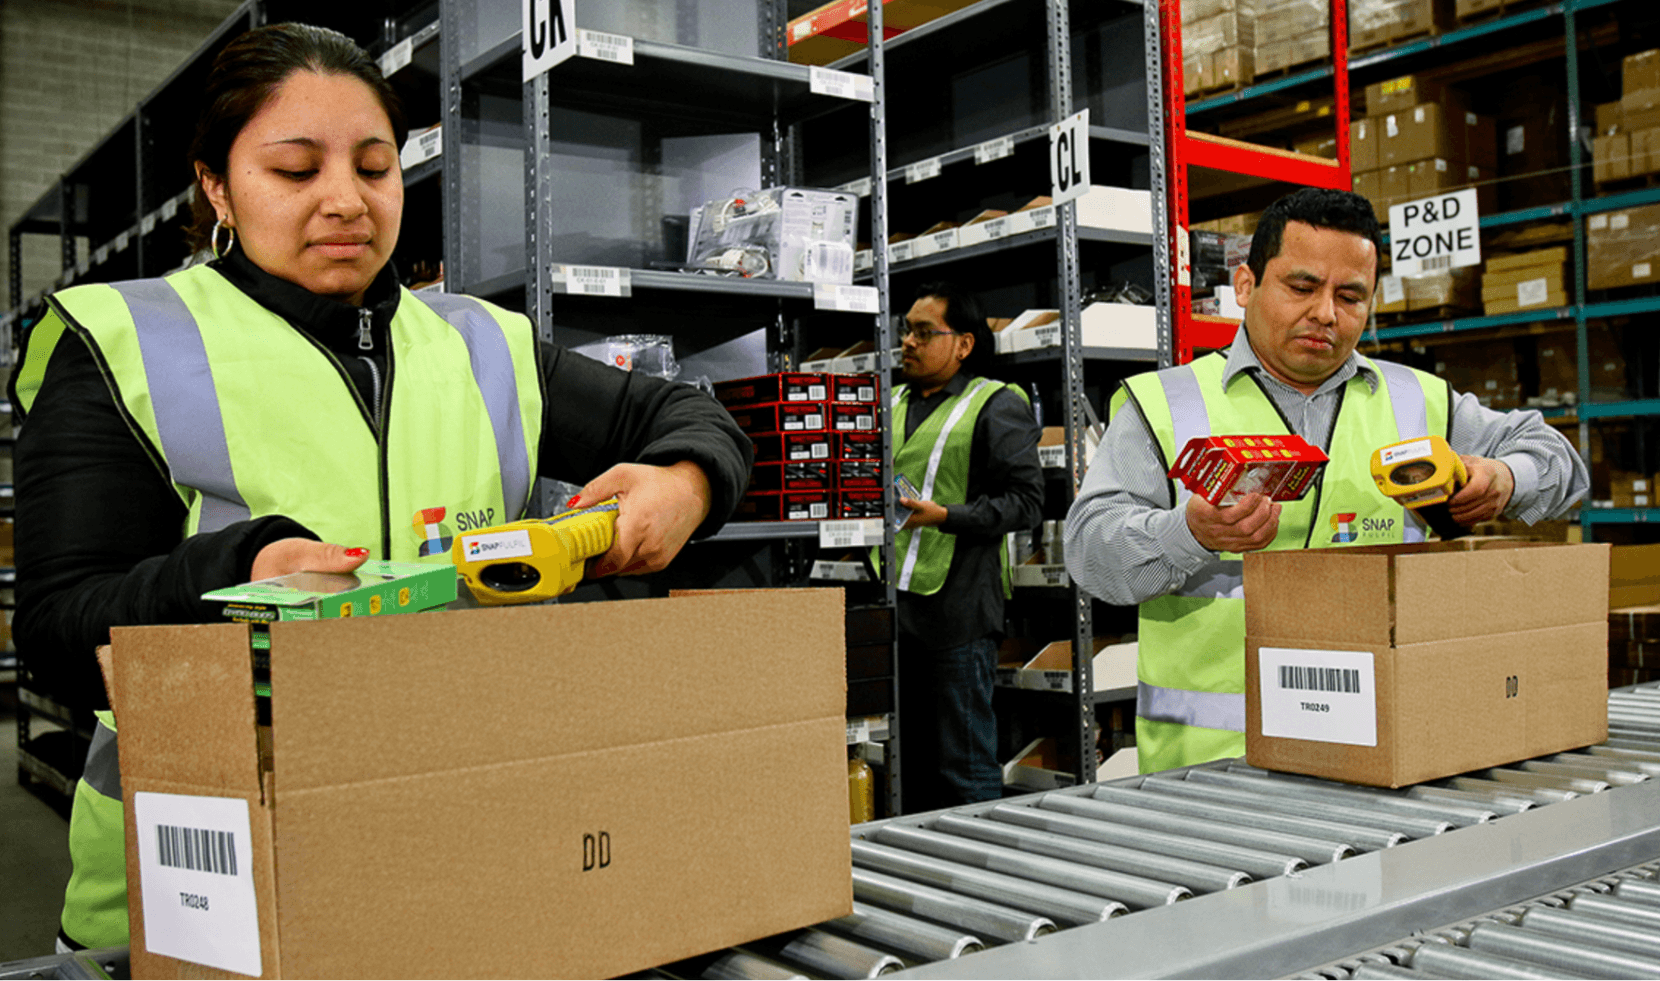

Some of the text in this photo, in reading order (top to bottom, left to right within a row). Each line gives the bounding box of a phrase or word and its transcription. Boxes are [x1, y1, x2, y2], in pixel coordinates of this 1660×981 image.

[1057, 127, 1081, 192] CL
[1404, 197, 1460, 228] P&D
[1396, 227, 1473, 261] ZONE
[456, 508, 494, 531] SNAP
[1362, 518, 1395, 531] SNAP
[582, 830, 611, 872] DD
